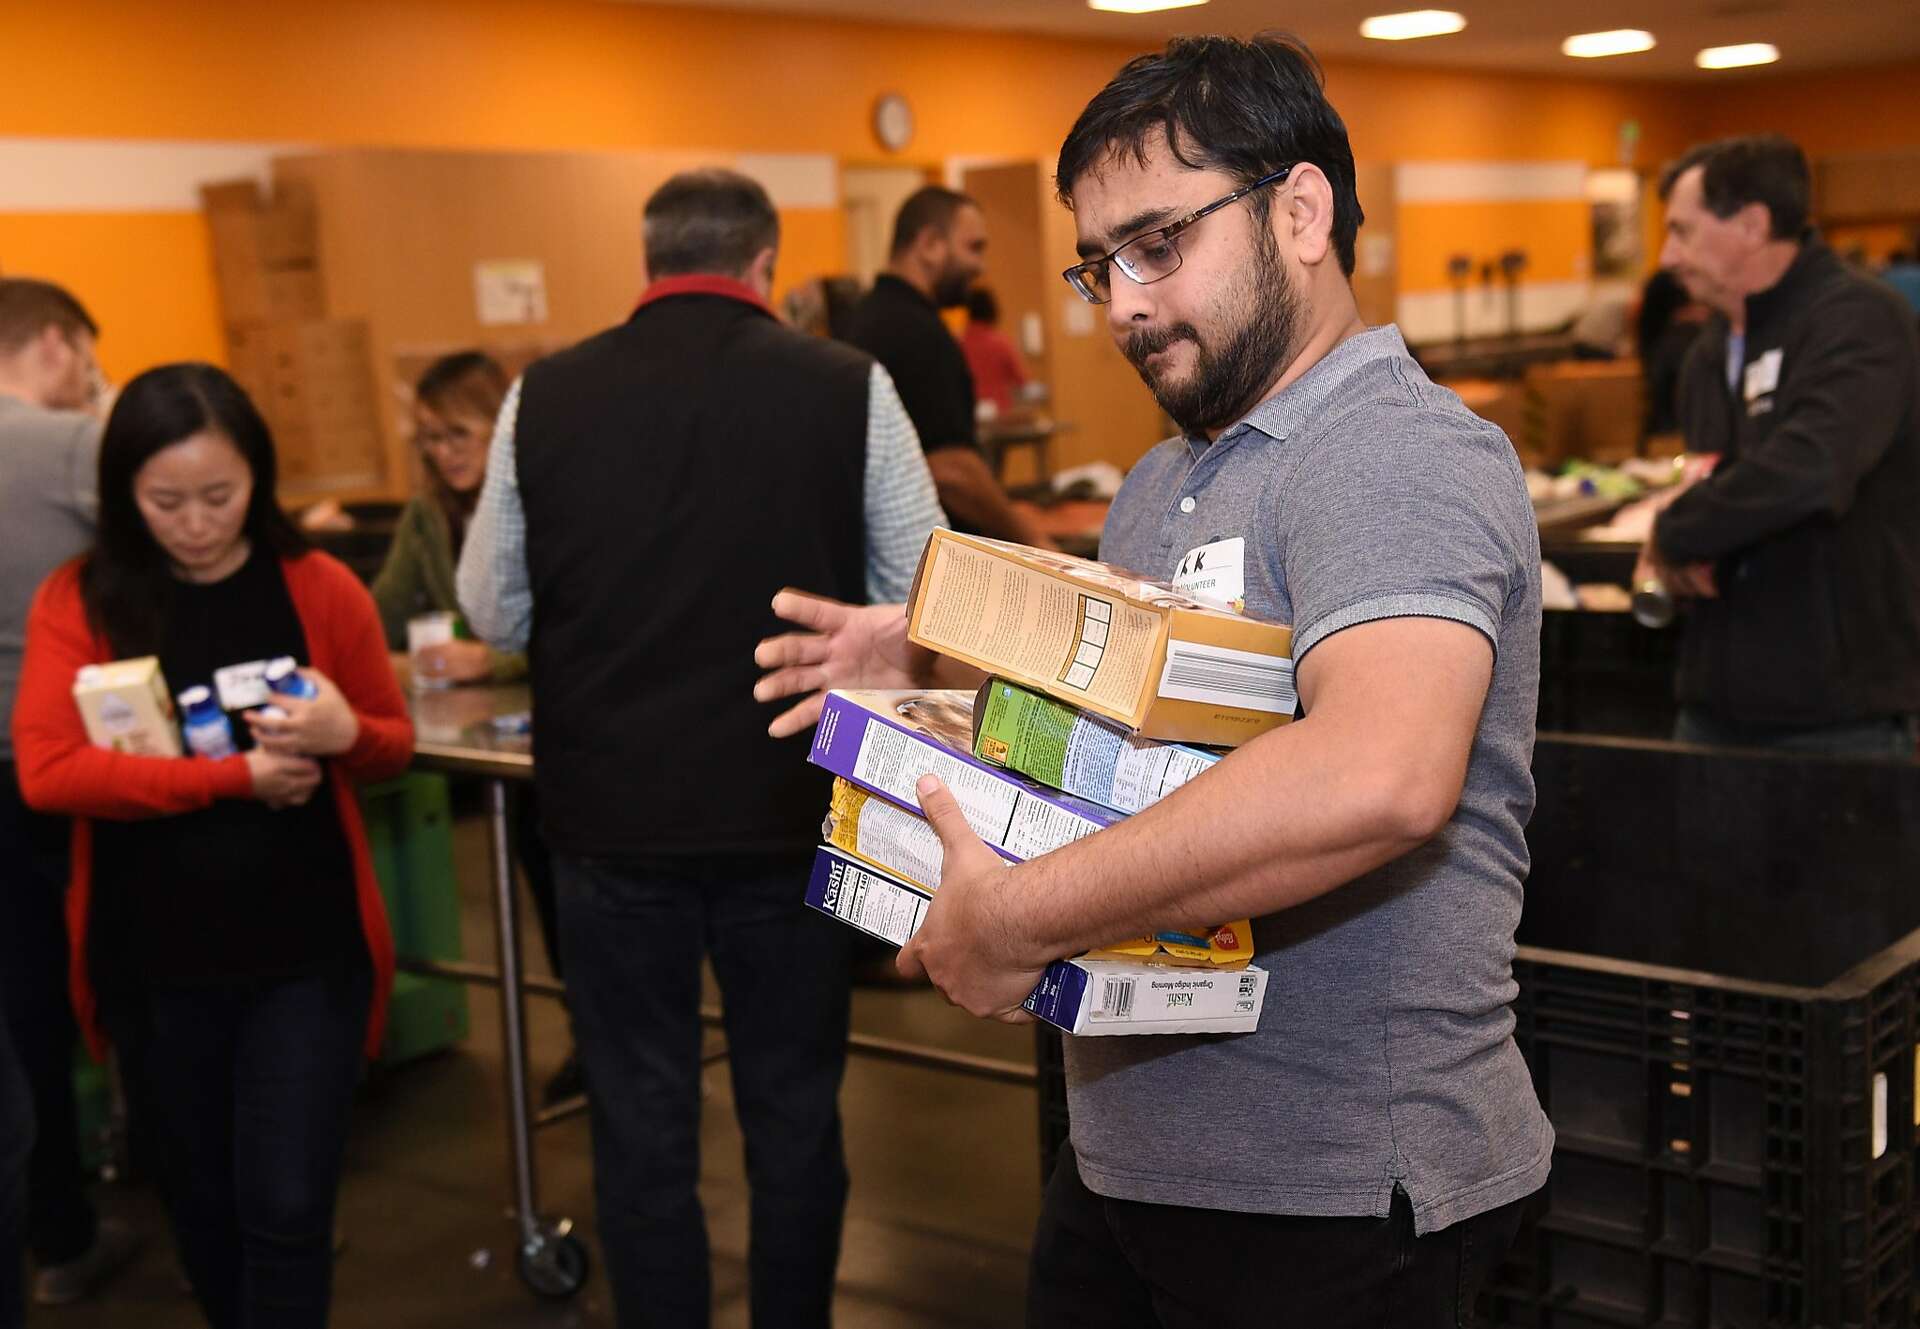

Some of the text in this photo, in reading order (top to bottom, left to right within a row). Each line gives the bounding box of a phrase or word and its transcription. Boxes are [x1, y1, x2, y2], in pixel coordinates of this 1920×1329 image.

[822, 860, 845, 912] Kashi
[836, 886, 847, 915] Nutrition
[843, 867, 852, 886] Facts
[853, 873, 869, 923] Calories 140
[1151, 980, 1213, 990] Organic Indigo Morning
[1167, 993, 1193, 1008] Kashi
